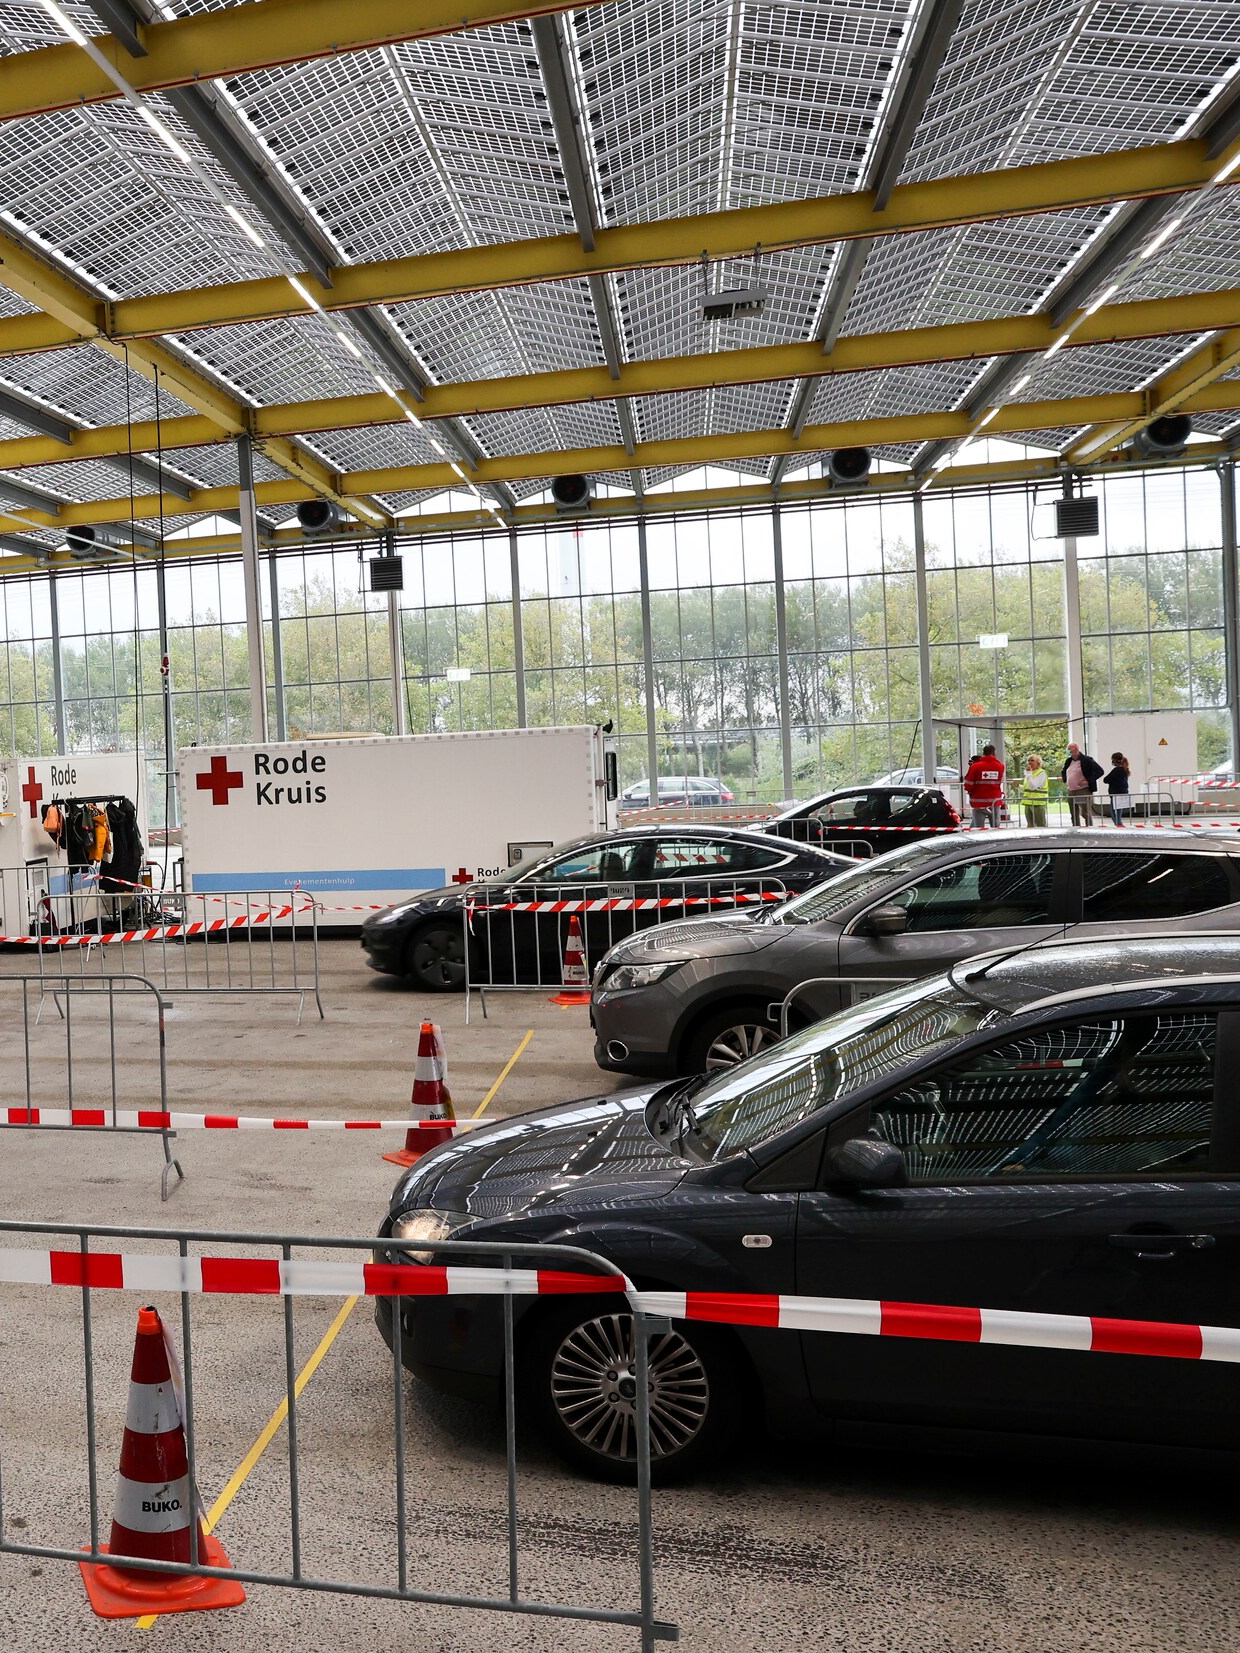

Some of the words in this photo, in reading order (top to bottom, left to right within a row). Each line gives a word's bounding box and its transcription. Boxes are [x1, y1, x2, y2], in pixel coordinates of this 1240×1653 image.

[51, 763, 77, 786] Rode
[254, 750, 326, 775] Rode
[256, 780, 327, 805] Kruis
